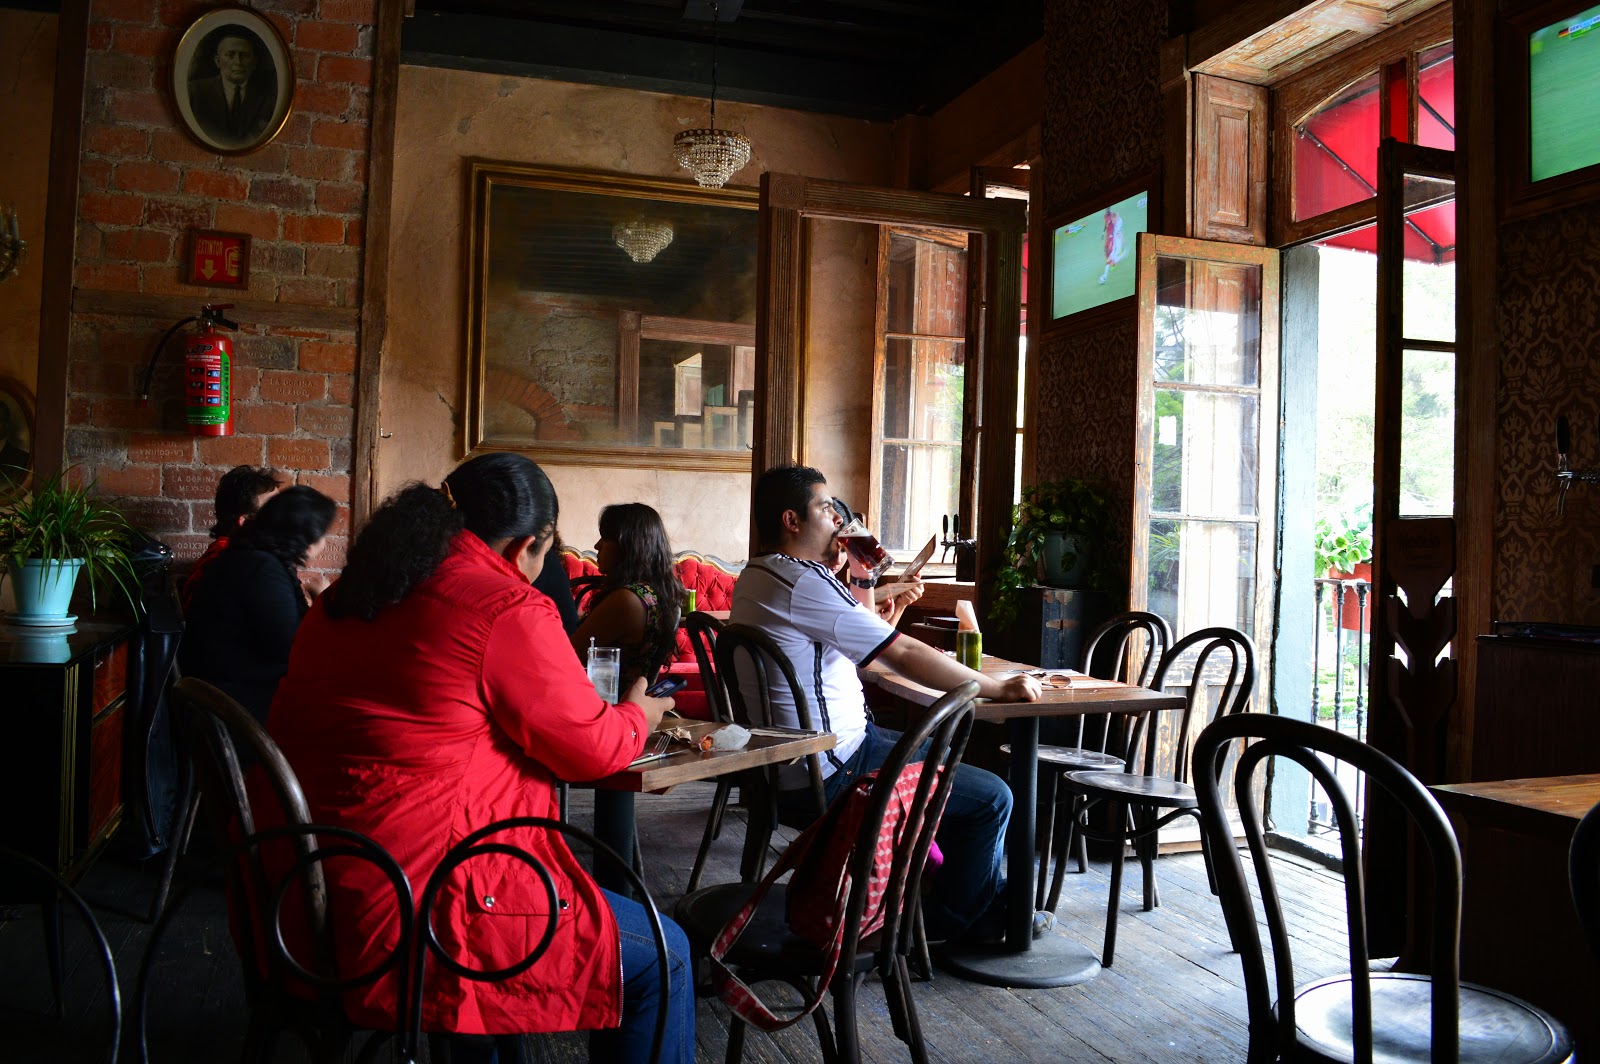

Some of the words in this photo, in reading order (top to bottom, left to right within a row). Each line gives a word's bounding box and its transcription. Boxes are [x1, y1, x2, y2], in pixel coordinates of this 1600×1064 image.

[197, 239, 224, 257] EXTINTOR
[270, 378, 281, 386] LA
[284, 380, 314, 388] CORINA
[277, 387, 309, 396] MEXICO
[172, 475, 182, 483] LA
